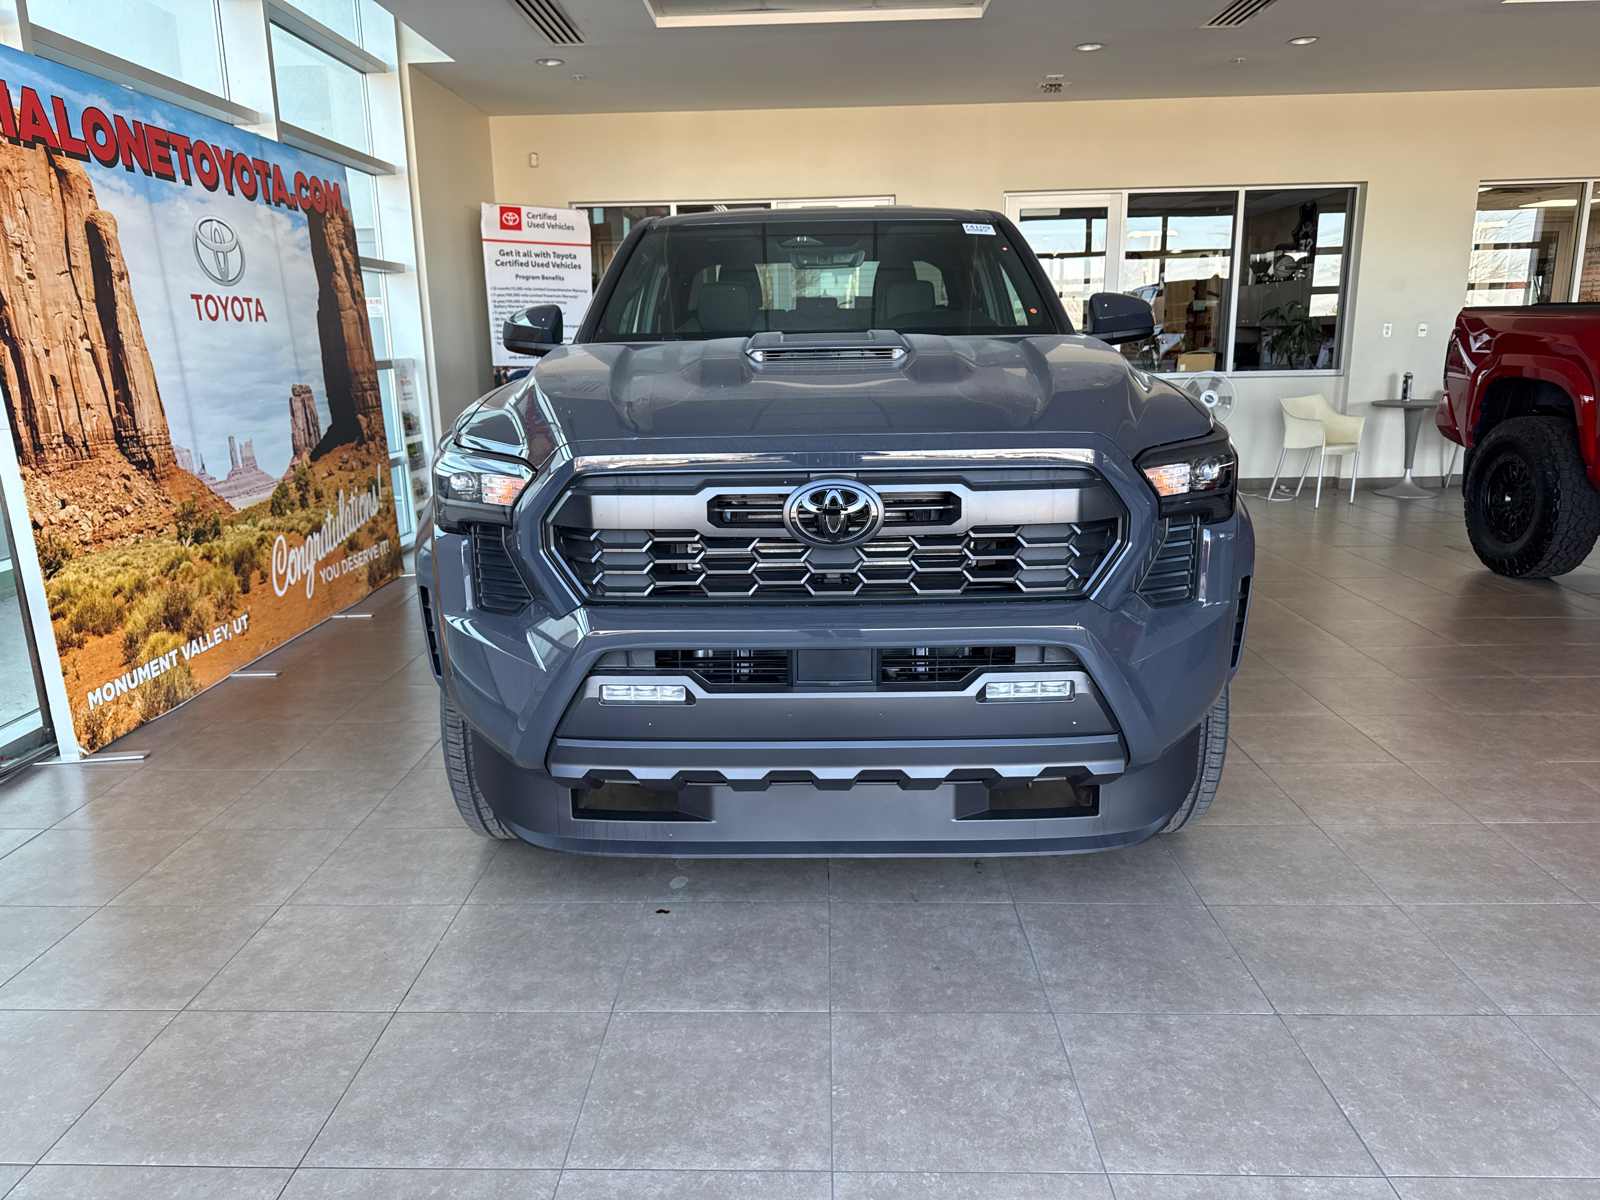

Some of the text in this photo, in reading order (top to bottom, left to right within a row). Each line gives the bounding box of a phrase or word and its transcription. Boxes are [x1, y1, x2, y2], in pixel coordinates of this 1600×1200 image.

[526, 212, 557, 221] Certified
[527, 221, 575, 231] Used Vehicles
[498, 249, 513, 257] Get
[522, 250, 532, 258] all
[533, 251, 551, 259] with
[552, 252, 577, 260] Toyota
[494, 259, 582, 270] Certified Used Vehicles
[515, 273, 540, 281] Program
[190, 294, 268, 322] TOYOTA
[271, 463, 384, 599] Congratulations!
[319, 540, 390, 585] YOU DESERVE IT!
[86, 613, 250, 710] MONUMENT VALLEY, UT
